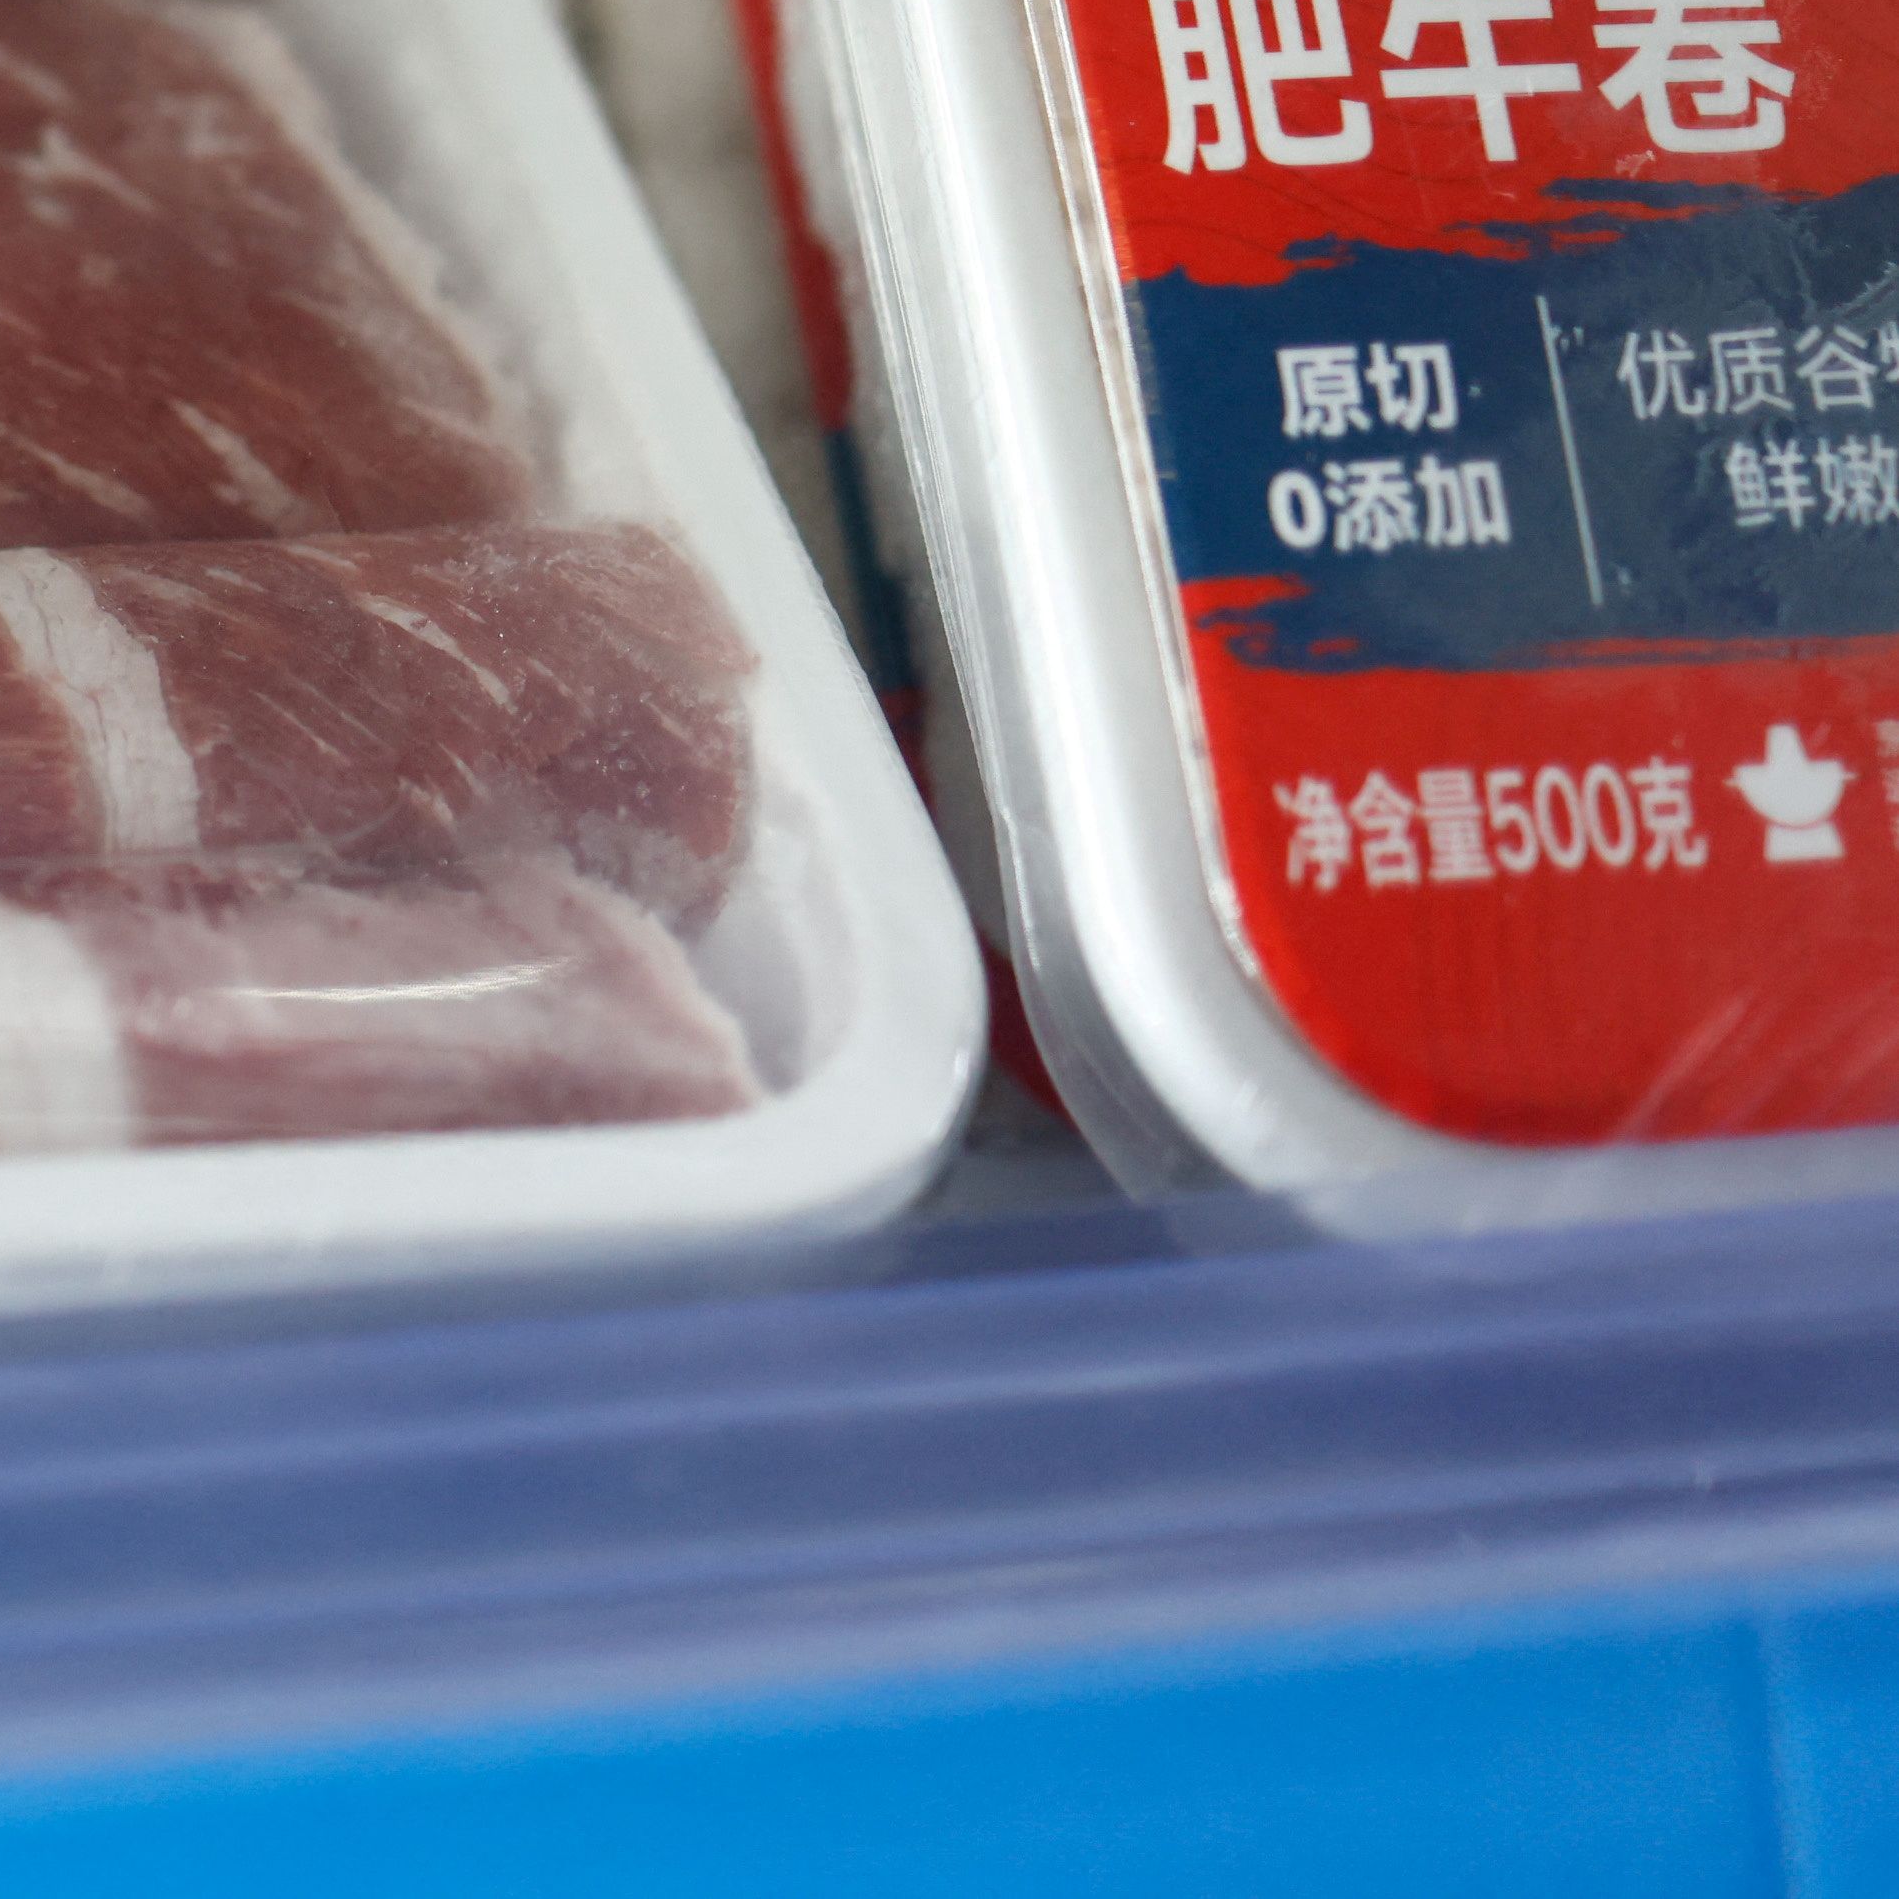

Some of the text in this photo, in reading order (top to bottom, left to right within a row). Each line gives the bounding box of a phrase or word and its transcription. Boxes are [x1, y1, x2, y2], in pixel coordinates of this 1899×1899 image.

[1276, 341, 1459, 439] 原切
[1267, 454, 1511, 554] 0添加
[1723, 433, 1899, 530] 鲜嫩
[1274, 755, 1709, 891] 净含量500克
